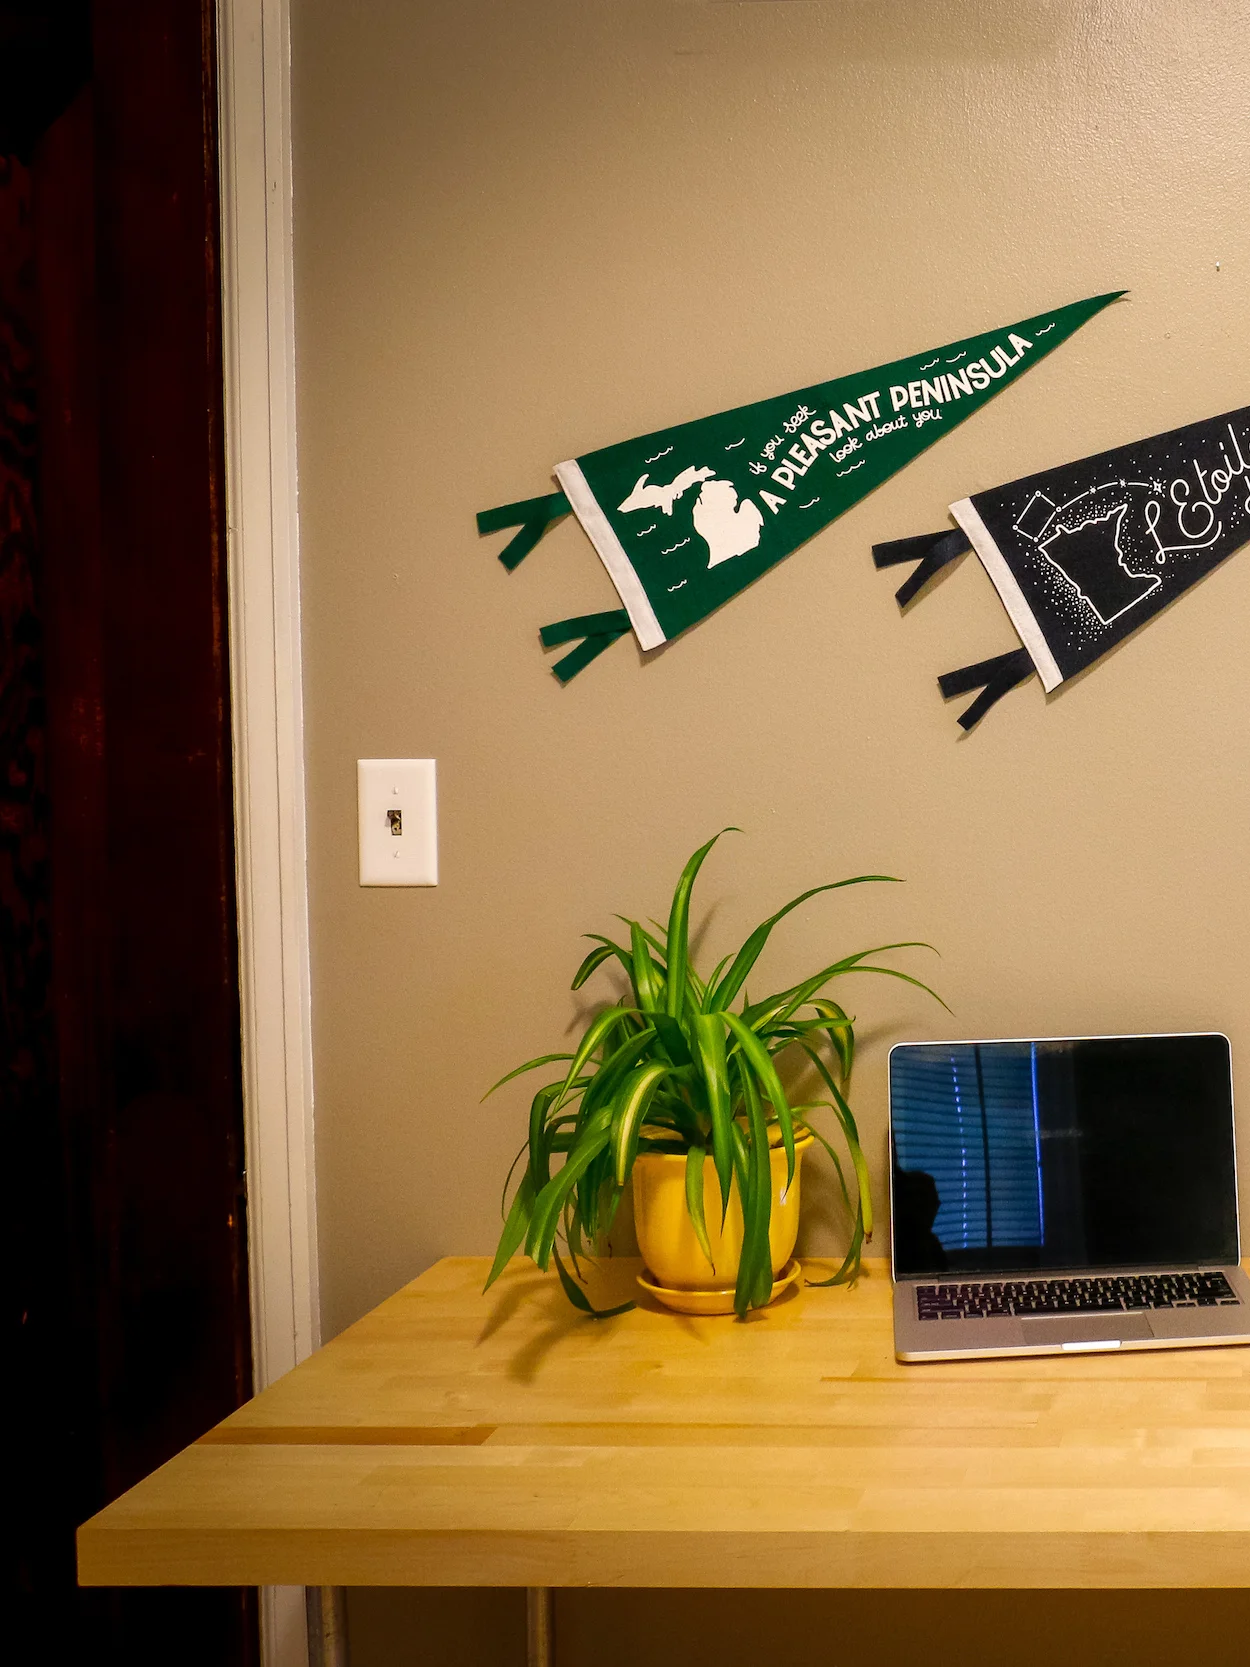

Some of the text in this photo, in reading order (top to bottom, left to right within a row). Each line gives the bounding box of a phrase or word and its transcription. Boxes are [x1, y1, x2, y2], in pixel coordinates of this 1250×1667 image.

[758, 332, 1033, 515] A PLEASANT PENINSULA
[760, 435, 785, 461] you
[783, 405, 817, 433] seek
[829, 408, 943, 463] look about you
